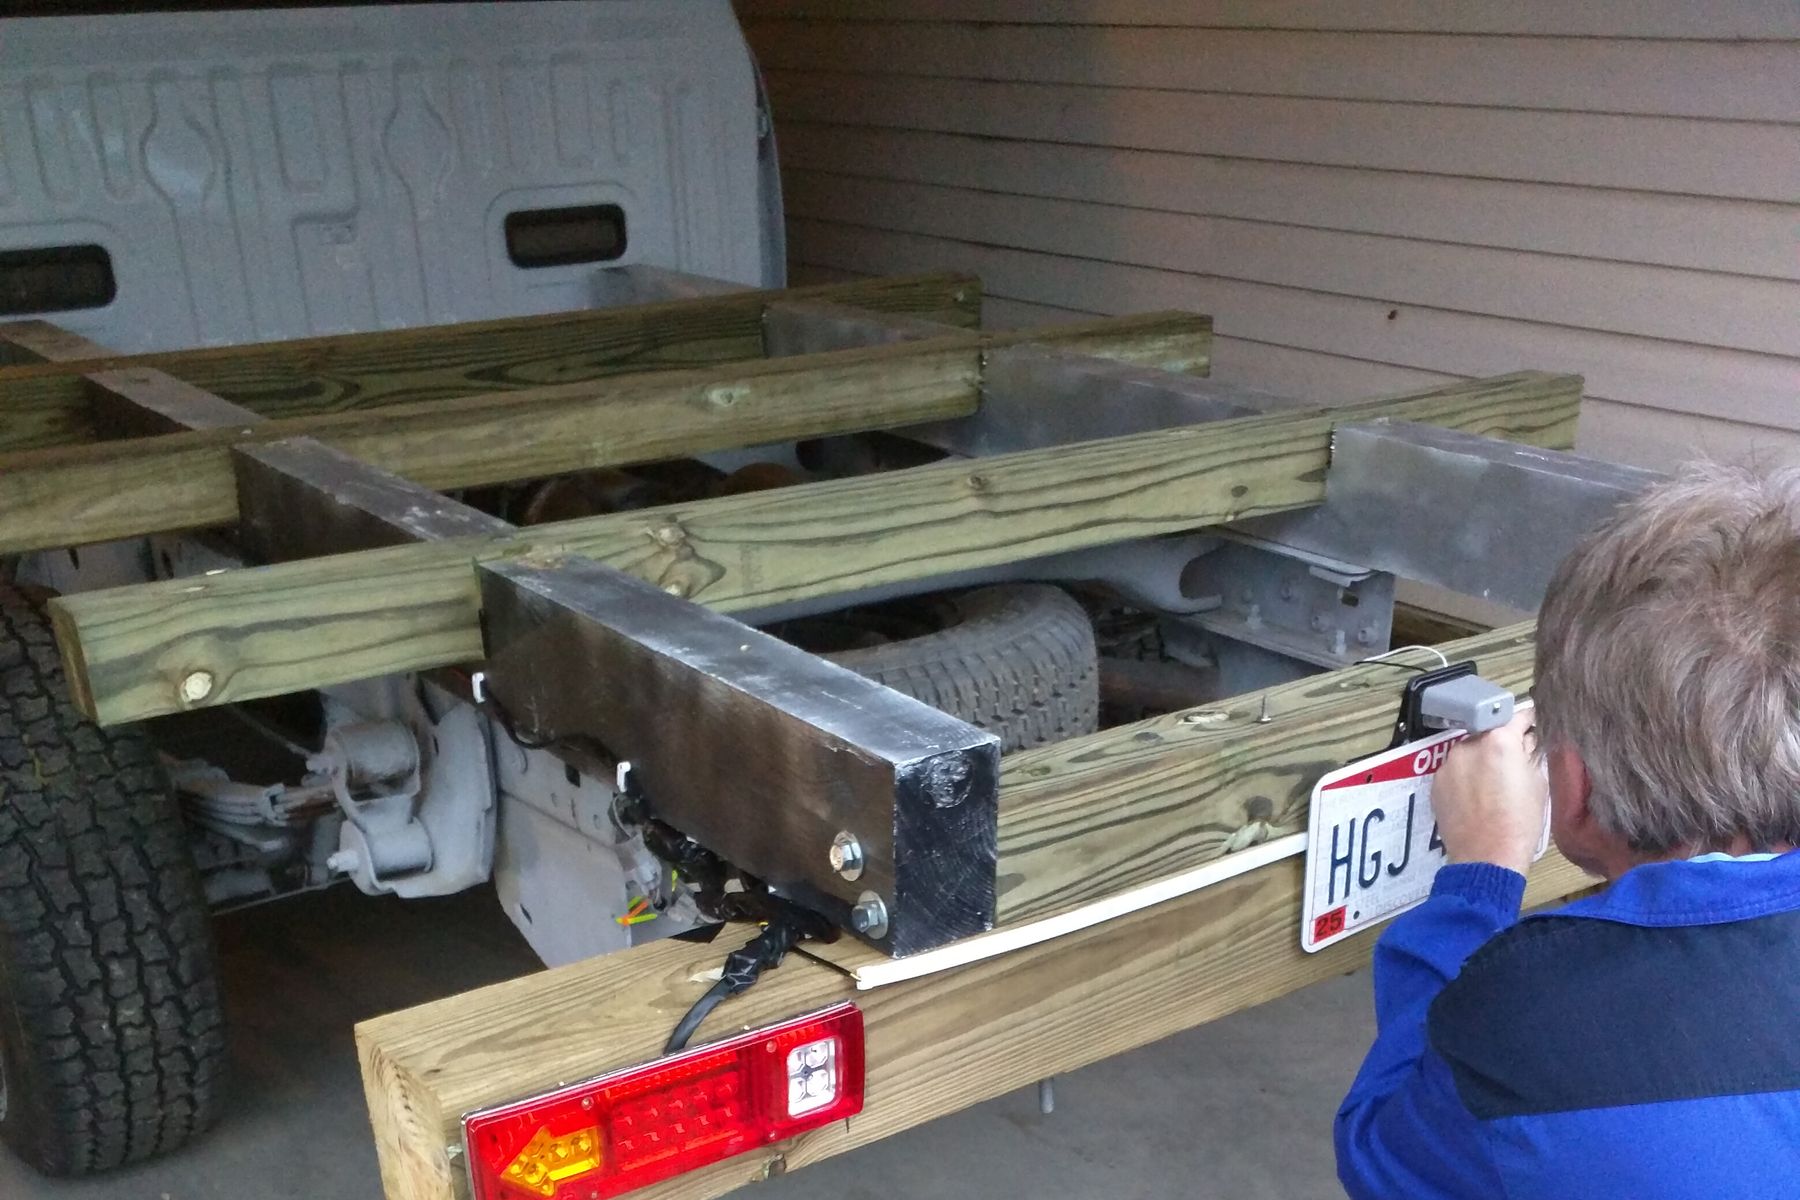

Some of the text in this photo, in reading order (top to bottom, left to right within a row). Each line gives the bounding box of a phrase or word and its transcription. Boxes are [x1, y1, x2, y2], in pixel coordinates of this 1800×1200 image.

[1413, 739, 1456, 775] OH
[1328, 793, 1415, 905] HGJ
[1315, 913, 1343, 937] 25
